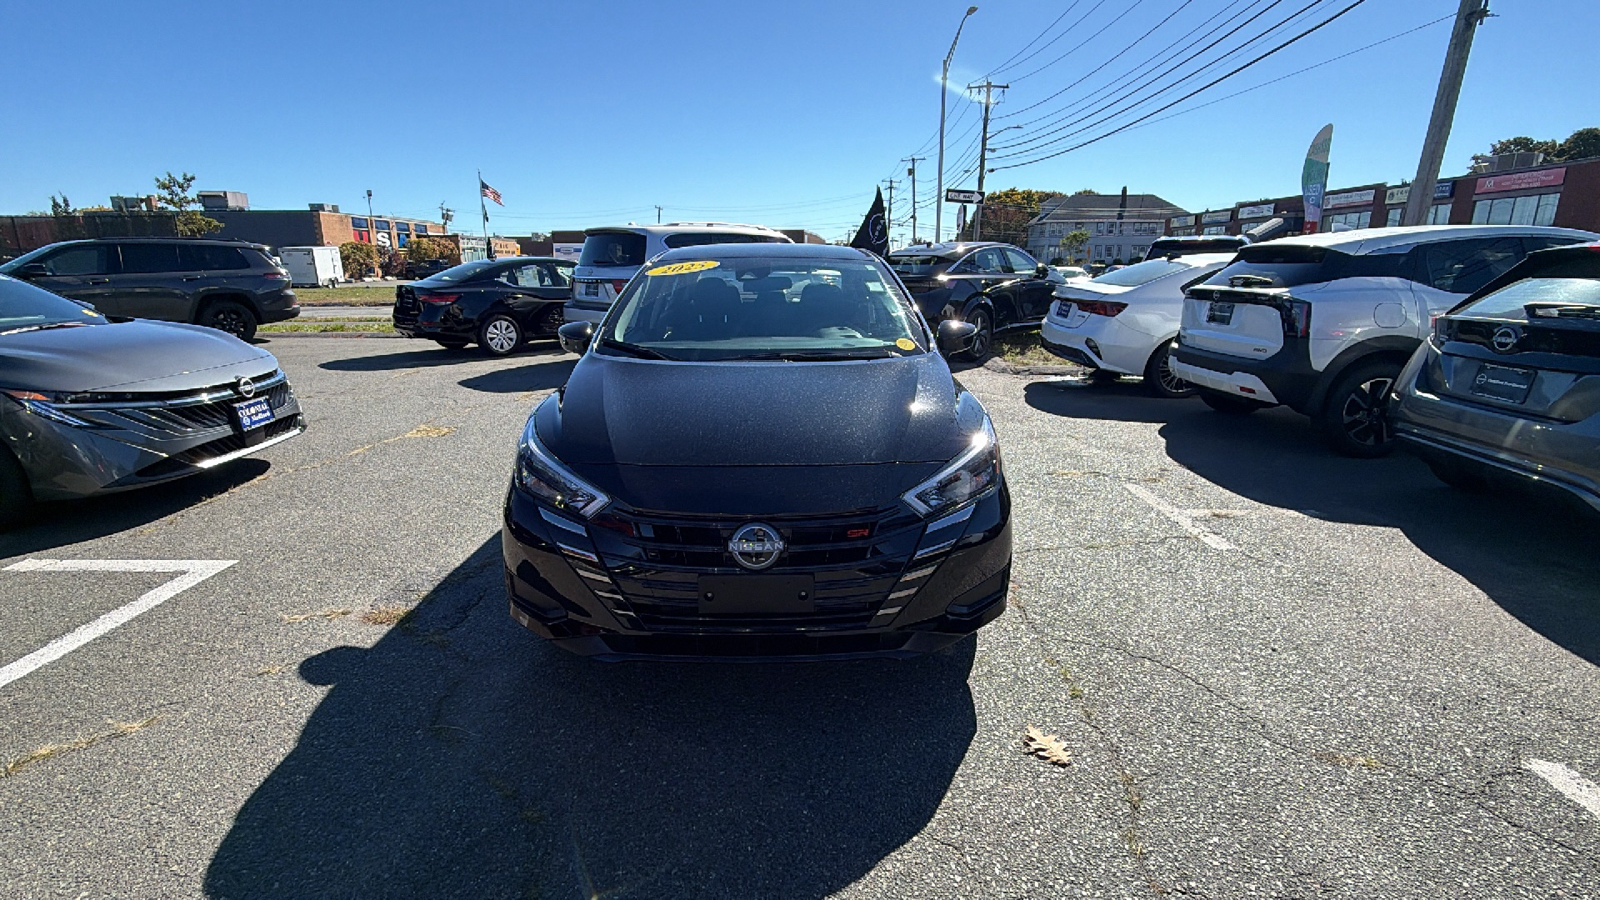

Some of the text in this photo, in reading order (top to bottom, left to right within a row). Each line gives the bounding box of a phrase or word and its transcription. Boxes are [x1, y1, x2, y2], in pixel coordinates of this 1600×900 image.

[660, 261, 708, 274] 2025
[847, 528, 869, 537] SR
[729, 541, 783, 551] NISSAN
